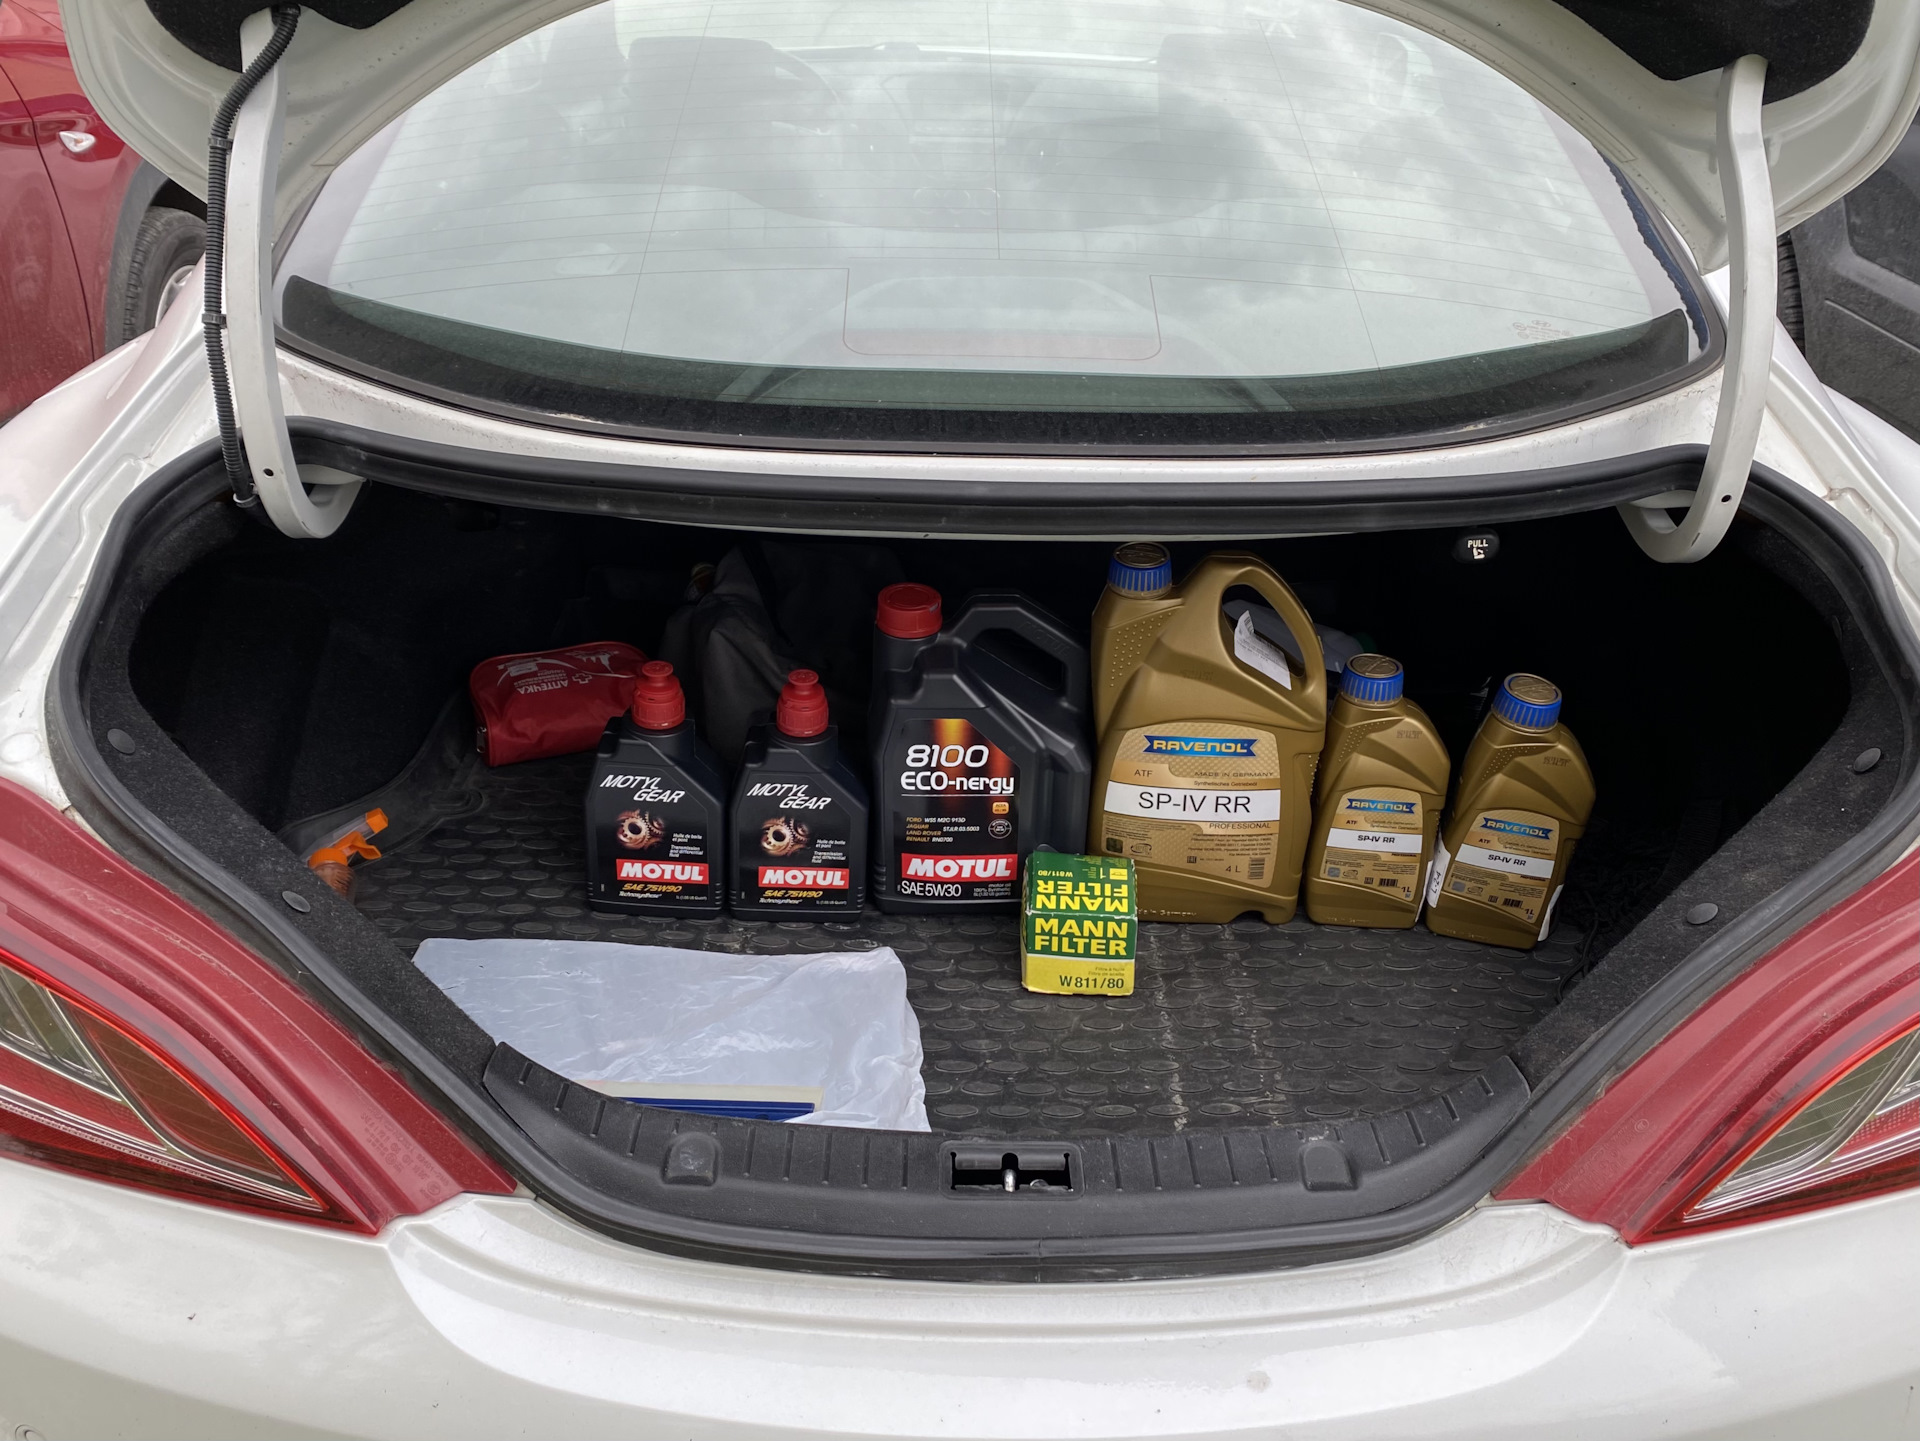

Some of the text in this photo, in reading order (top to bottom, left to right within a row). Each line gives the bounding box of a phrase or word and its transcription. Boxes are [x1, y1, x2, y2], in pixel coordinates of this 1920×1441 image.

[1467, 539, 1489, 548] PULL
[516, 680, 569, 694] АПТЕЧКА
[1152, 739, 1248, 753] RAVENOL
[905, 744, 989, 768] 8100
[1133, 769, 1153, 778] ATF
[599, 774, 662, 790] MOTYL
[746, 783, 809, 797] MOTYL
[900, 771, 1015, 794] ECO-nergy
[633, 788, 686, 803] GEAR
[779, 796, 832, 810] GEAR
[1138, 791, 1252, 814] SP-IV RR
[1351, 801, 1410, 811] RAVENOL
[1486, 820, 1546, 837] RAVENOL
[906, 858, 1011, 878] MOTUL
[1487, 854, 1527, 867] SP-IV RR
[620, 862, 703, 881] MOTUL
[762, 869, 845, 886] MOTUL
[622, 883, 683, 893] SAE 75W90
[785, 890, 824, 898] 75W90
[901, 880, 962, 897] SAE 5W30
[1036, 879, 1128, 897] FILTER
[1035, 894, 1129, 913] MANN
[1034, 917, 1128, 939] MANN
[1034, 935, 1127, 956] FILTER
